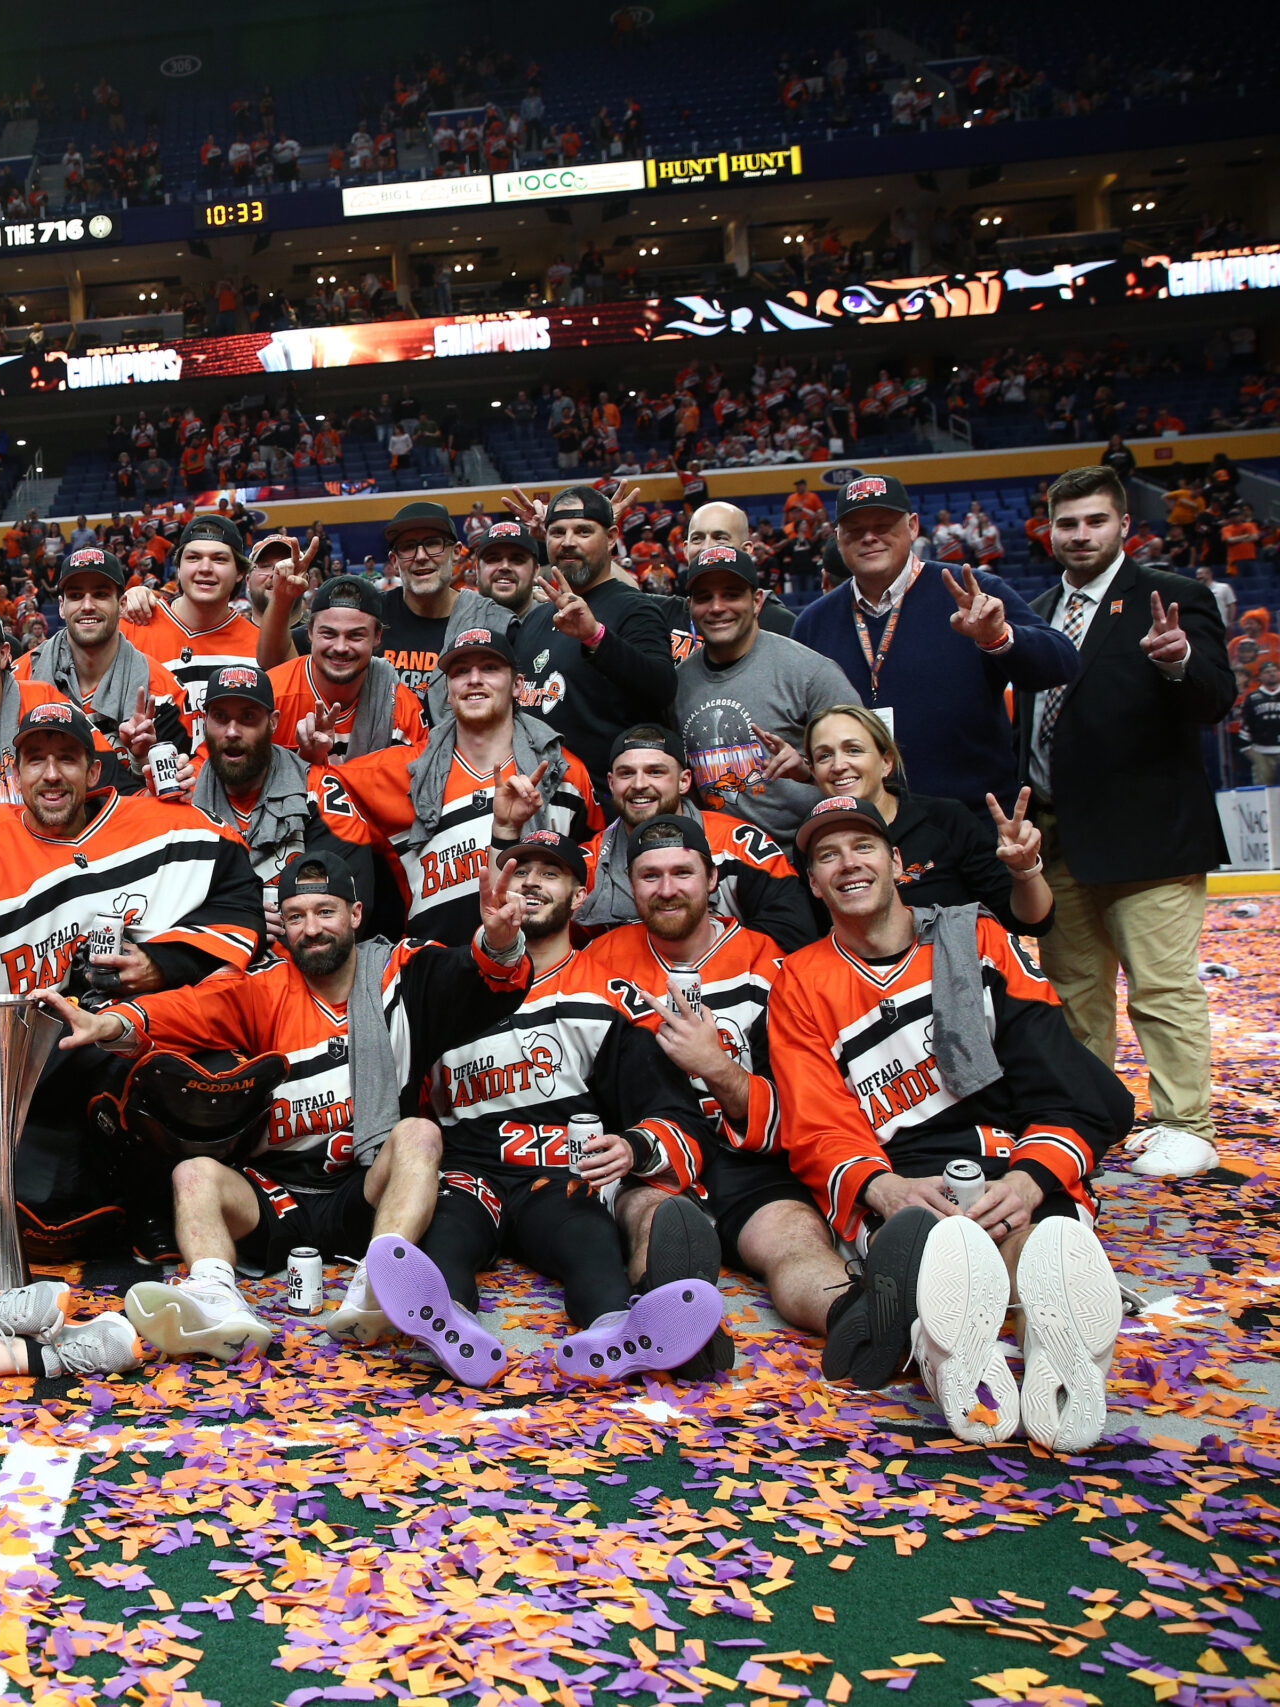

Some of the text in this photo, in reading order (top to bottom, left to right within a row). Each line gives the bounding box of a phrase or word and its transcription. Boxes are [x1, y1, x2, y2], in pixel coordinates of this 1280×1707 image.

[659, 157, 715, 178] HUNT
[730, 151, 787, 172] HUNT
[206, 201, 263, 226] 10:33
[5, 224, 35, 246] THE
[38, 218, 84, 244] 716
[700, 699, 741, 711] LACROSSE
[185, 1077, 256, 1093] BODDAM
[498, 1120, 570, 1168] 22
